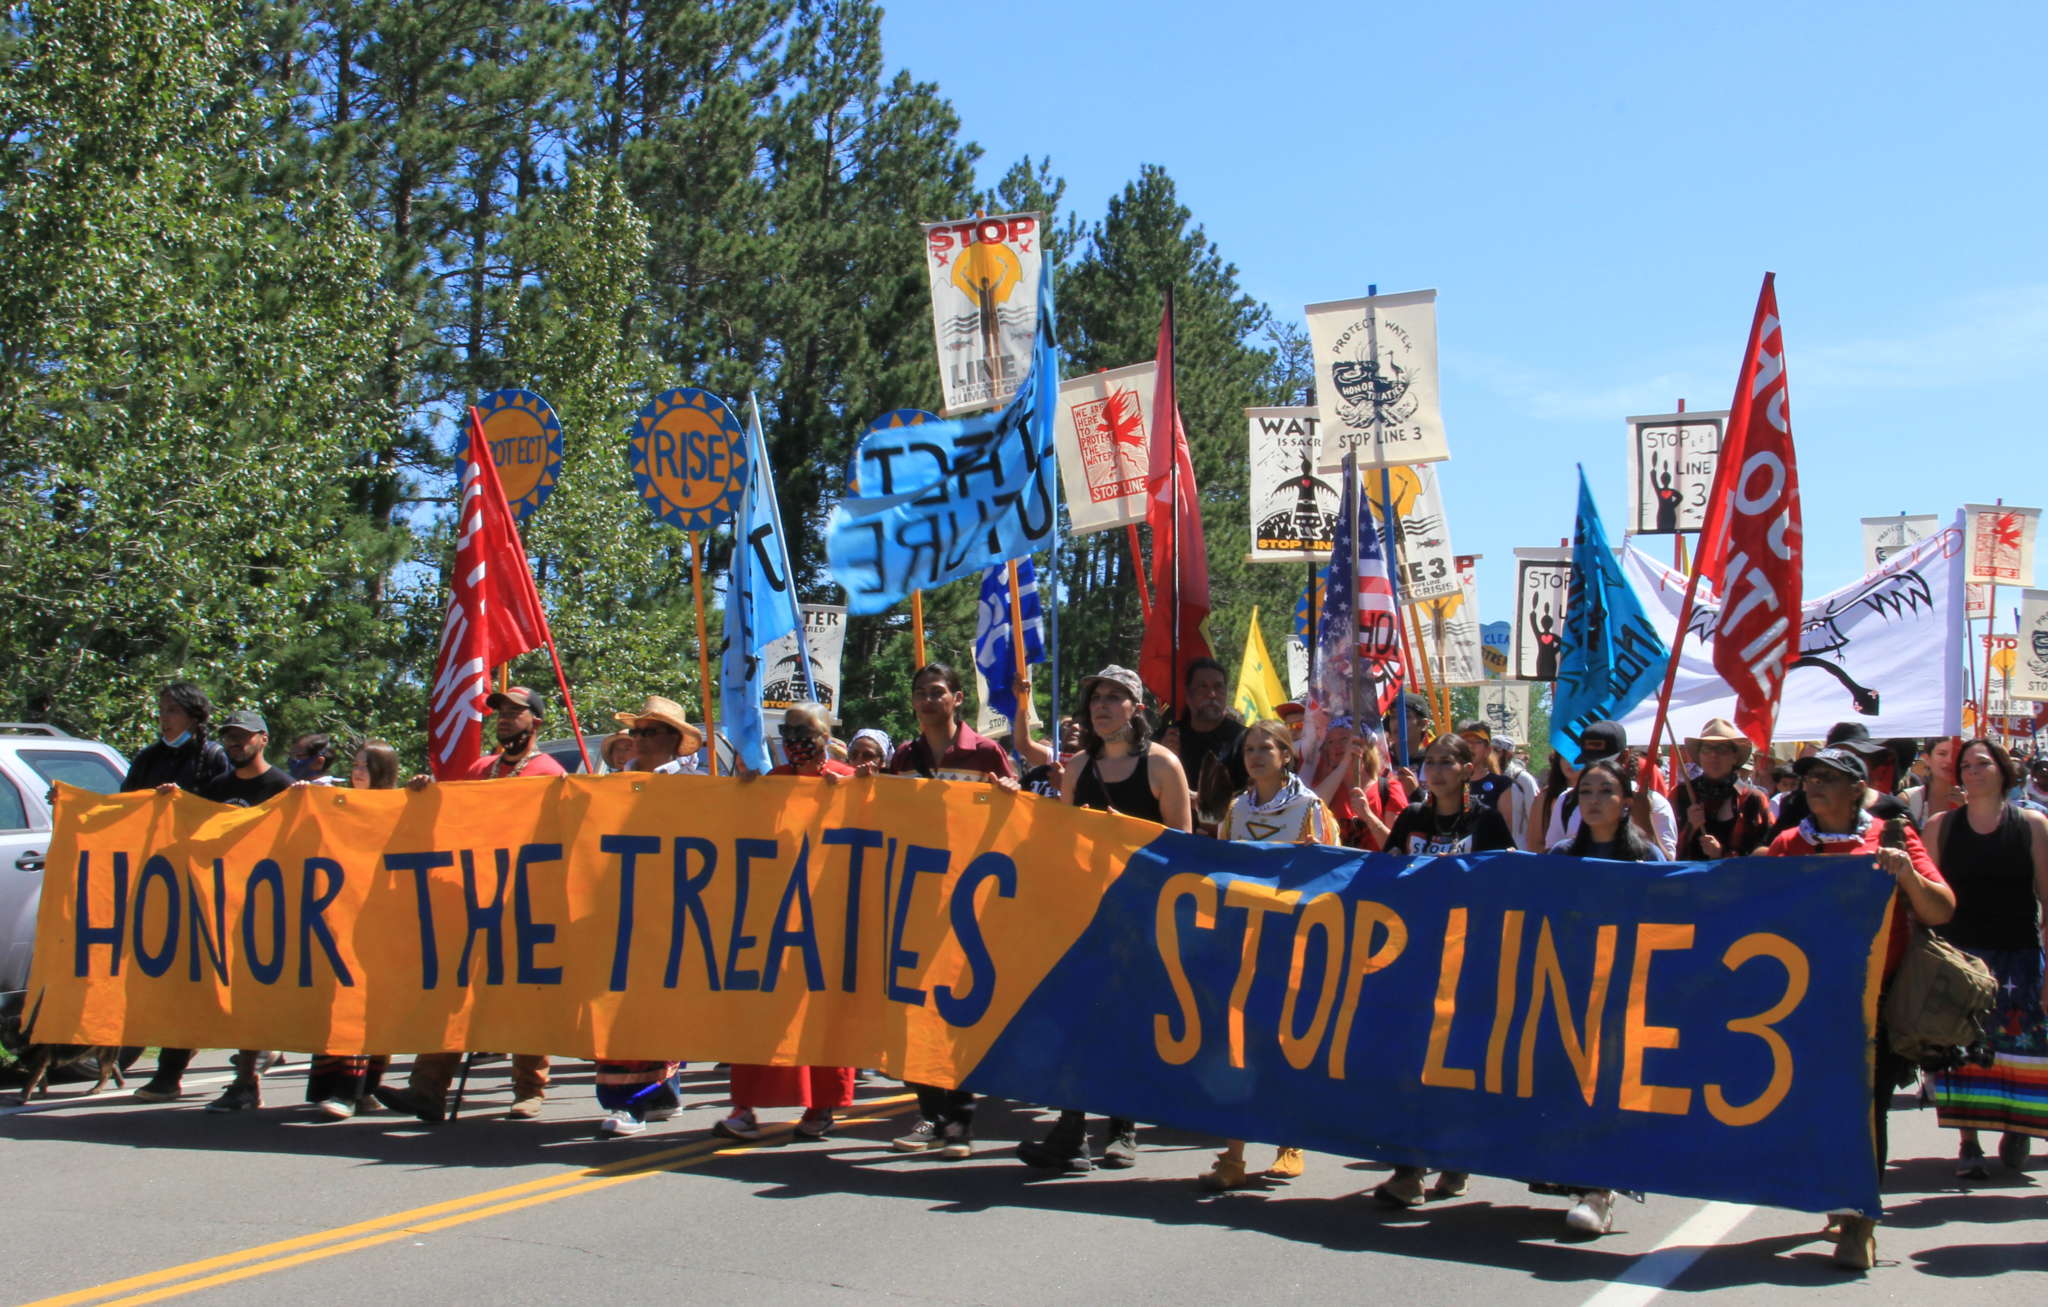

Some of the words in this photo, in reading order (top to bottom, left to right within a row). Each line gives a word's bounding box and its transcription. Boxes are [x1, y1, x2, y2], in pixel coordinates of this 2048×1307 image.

[928, 216, 1034, 252] STOP
[1332, 317, 1377, 354] PROTECT
[1385, 320, 1413, 354] WATER
[950, 354, 1017, 388] LINE
[1342, 381, 1374, 395] HONOR
[1075, 408, 1088, 418] WE
[1077, 415, 1099, 427] HERE
[1258, 417, 1320, 436] WAT
[1080, 428, 1091, 437] TO
[1338, 432, 1370, 448] STOP
[1377, 428, 1407, 444] LINE
[1413, 427, 1422, 440] 3
[1647, 430, 1690, 448] STOP
[1278, 438, 1287, 446] IS
[1291, 438, 1321, 447] SACR
[490, 436, 545, 467] OTECT
[654, 430, 726, 483] RISE
[1084, 446, 1098, 457] THE
[1675, 461, 1712, 475] LINE
[1093, 484, 1119, 500] STOP
[1124, 479, 1147, 493] LINE
[1691, 483, 1706, 507] 3
[1258, 539, 1301, 549] STOP
[1304, 540, 1334, 550] LIN
[1429, 557, 1446, 579] 3
[1414, 582, 1454, 597] CRISIS
[802, 611, 838, 626] TER
[802, 625, 826, 633] CRED
[1484, 633, 1510, 645] CLEA
[1982, 636, 2017, 649] STO
[2029, 681, 2048, 691] STO
[989, 716, 1006, 729] STOP
[75, 850, 354, 987] HONOR
[384, 843, 562, 989] THE
[601, 828, 1017, 1027] TREATIES
[1154, 872, 1408, 1080] STOP
[1421, 908, 1695, 1115] LINE
[1704, 933, 1809, 1126] 3
